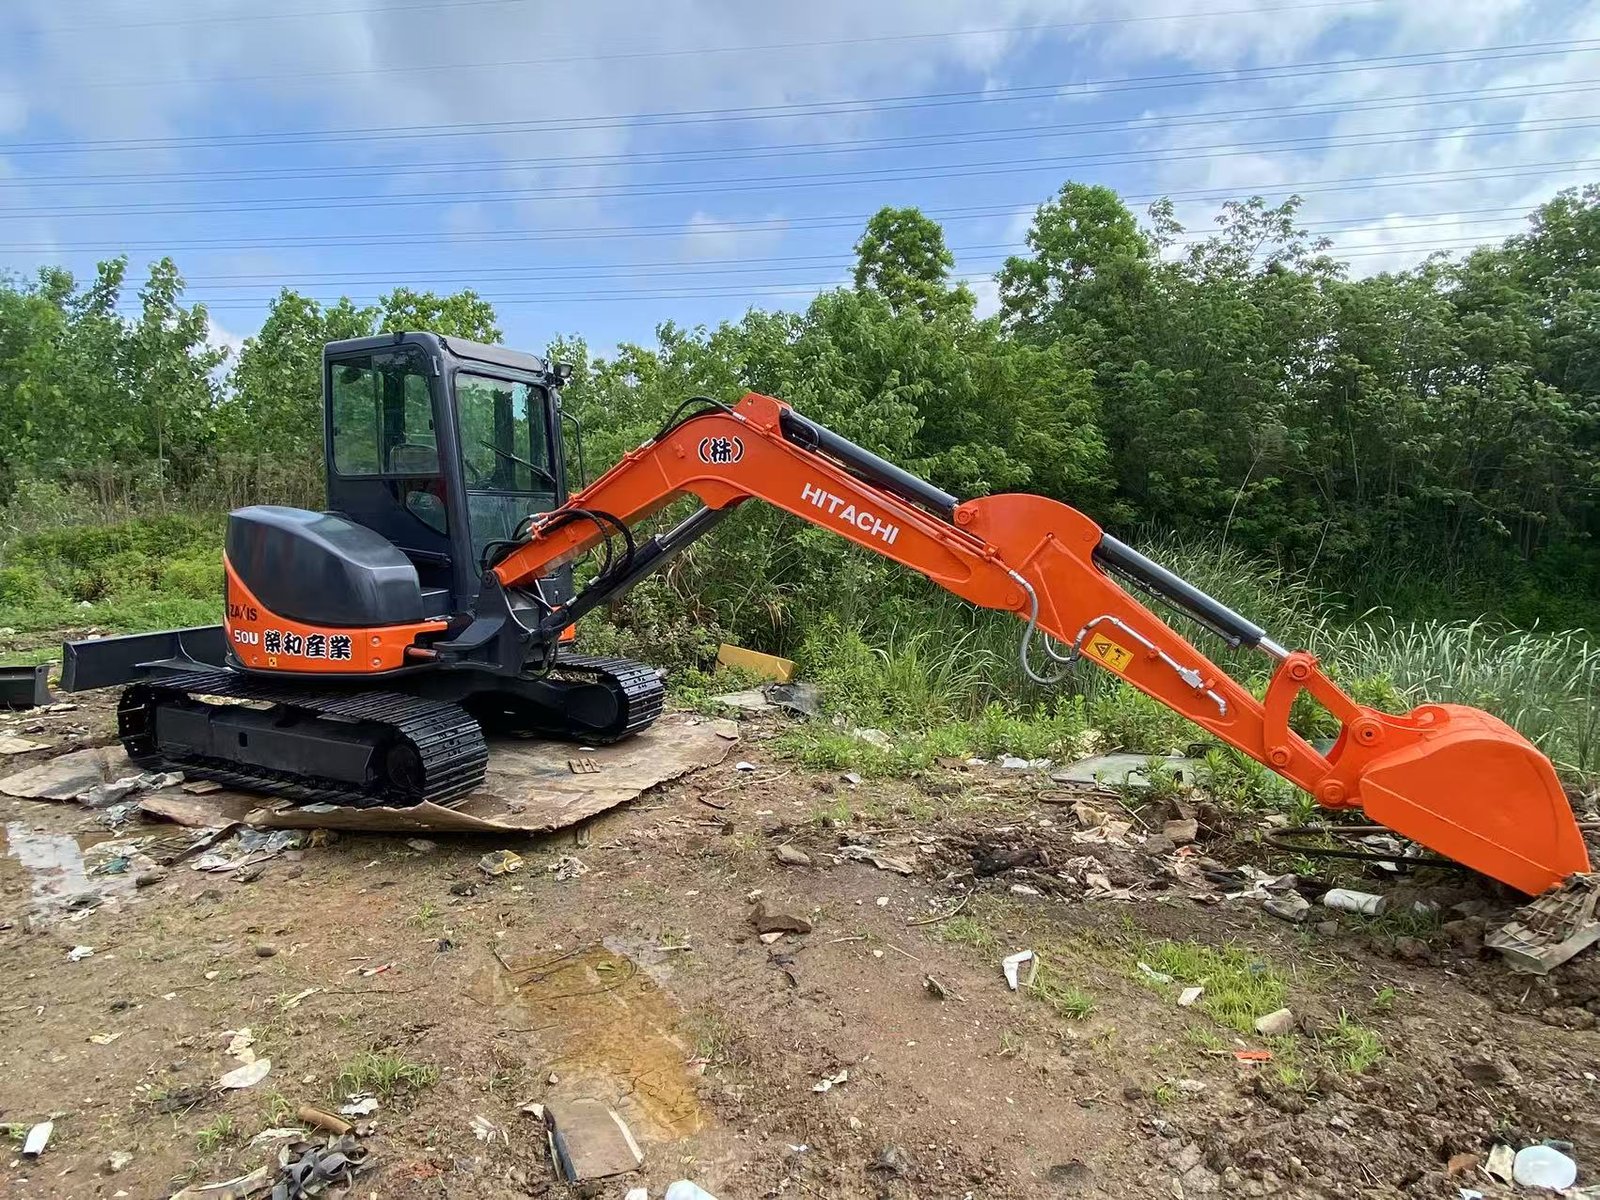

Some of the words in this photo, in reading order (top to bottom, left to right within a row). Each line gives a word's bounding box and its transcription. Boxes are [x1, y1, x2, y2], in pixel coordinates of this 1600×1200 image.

[698, 436, 744, 464] (株)
[801, 483, 899, 544] HITACHI
[230, 603, 257, 622] ZAXIS
[234, 629, 259, 645] 50U
